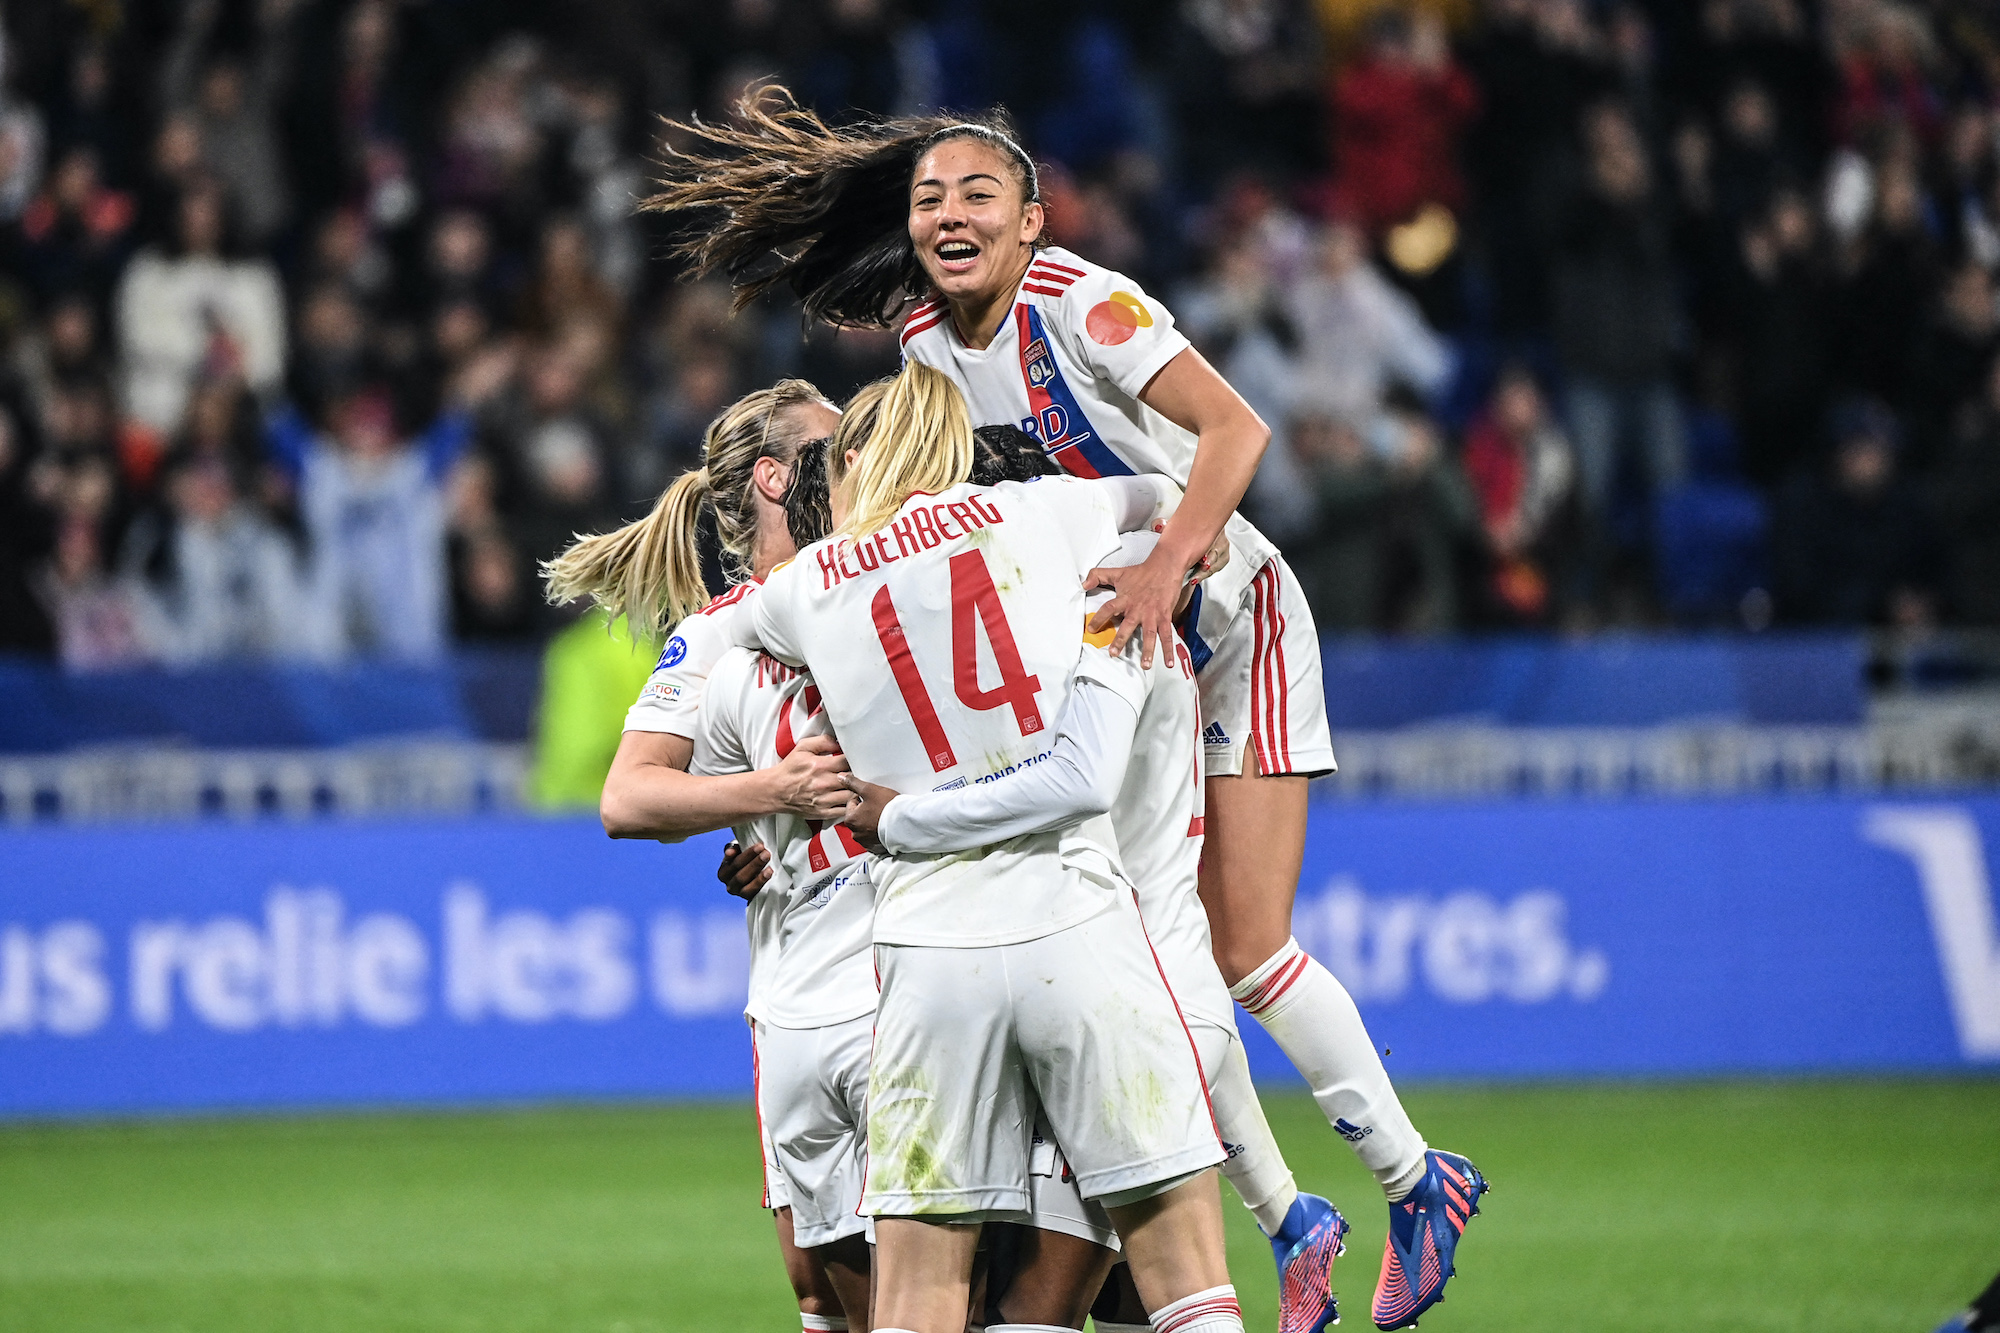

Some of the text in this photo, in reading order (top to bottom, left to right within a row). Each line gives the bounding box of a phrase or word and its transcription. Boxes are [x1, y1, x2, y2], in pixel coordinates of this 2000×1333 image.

[1020, 403, 1069, 446] RD
[816, 494, 1004, 590] HEGERBERG
[871, 549, 1045, 773] 14
[1203, 735, 1230, 744] didas
[132, 886, 428, 1031] relie
[442, 880, 637, 1023] les
[1292, 872, 1609, 1002] tres.
[1346, 1126, 1373, 1142] das
